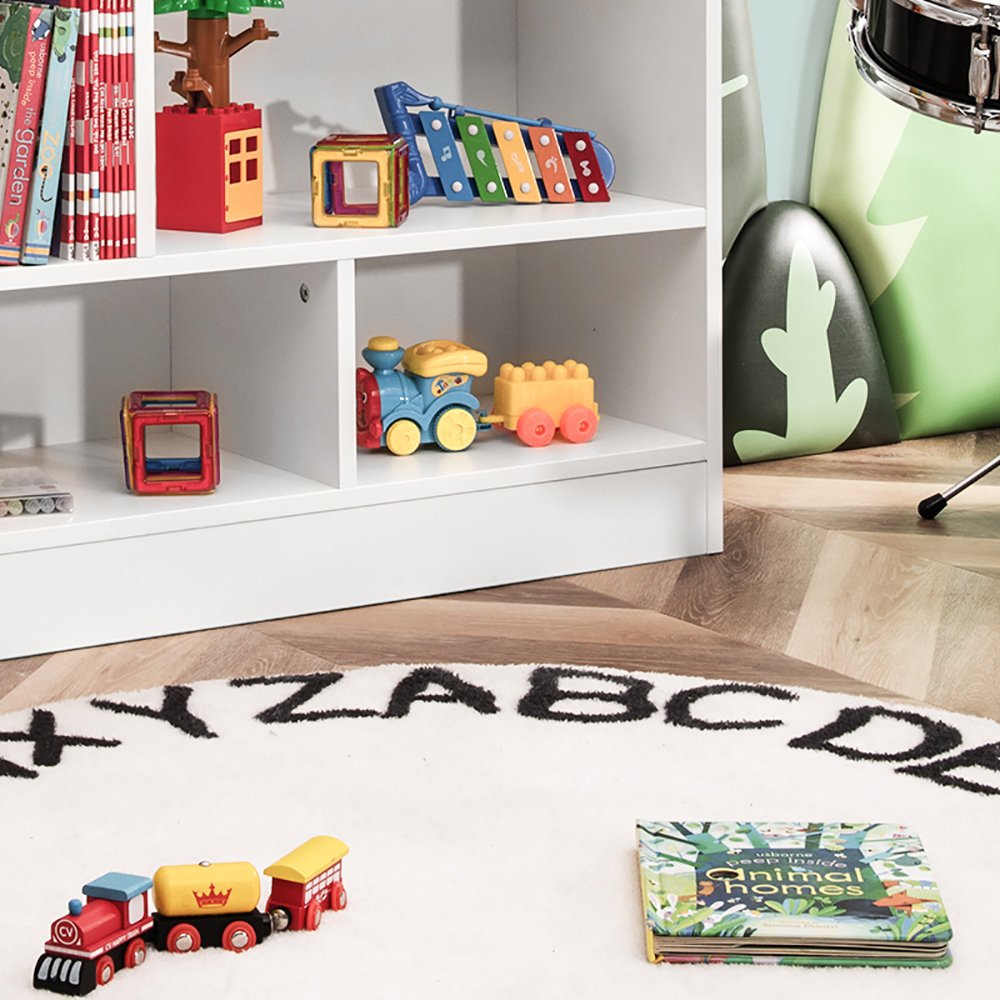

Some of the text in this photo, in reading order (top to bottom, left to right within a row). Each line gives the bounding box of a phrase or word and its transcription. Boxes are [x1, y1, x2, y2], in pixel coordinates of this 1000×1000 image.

[36, 43, 47, 78] usborne
[21, 51, 36, 106] peep inside
[9, 107, 36, 206] the garden
[90, 685, 219, 739] Y
[229, 672, 383, 724] Z
[384, 665, 501, 719] A
[517, 666, 658, 723] B
[664, 683, 800, 731] C
[788, 705, 963, 762] D
[706, 867, 864, 883] animal
[726, 857, 847, 868] peep inside
[724, 880, 865, 896] homes
[59, 926, 73, 938] CV
